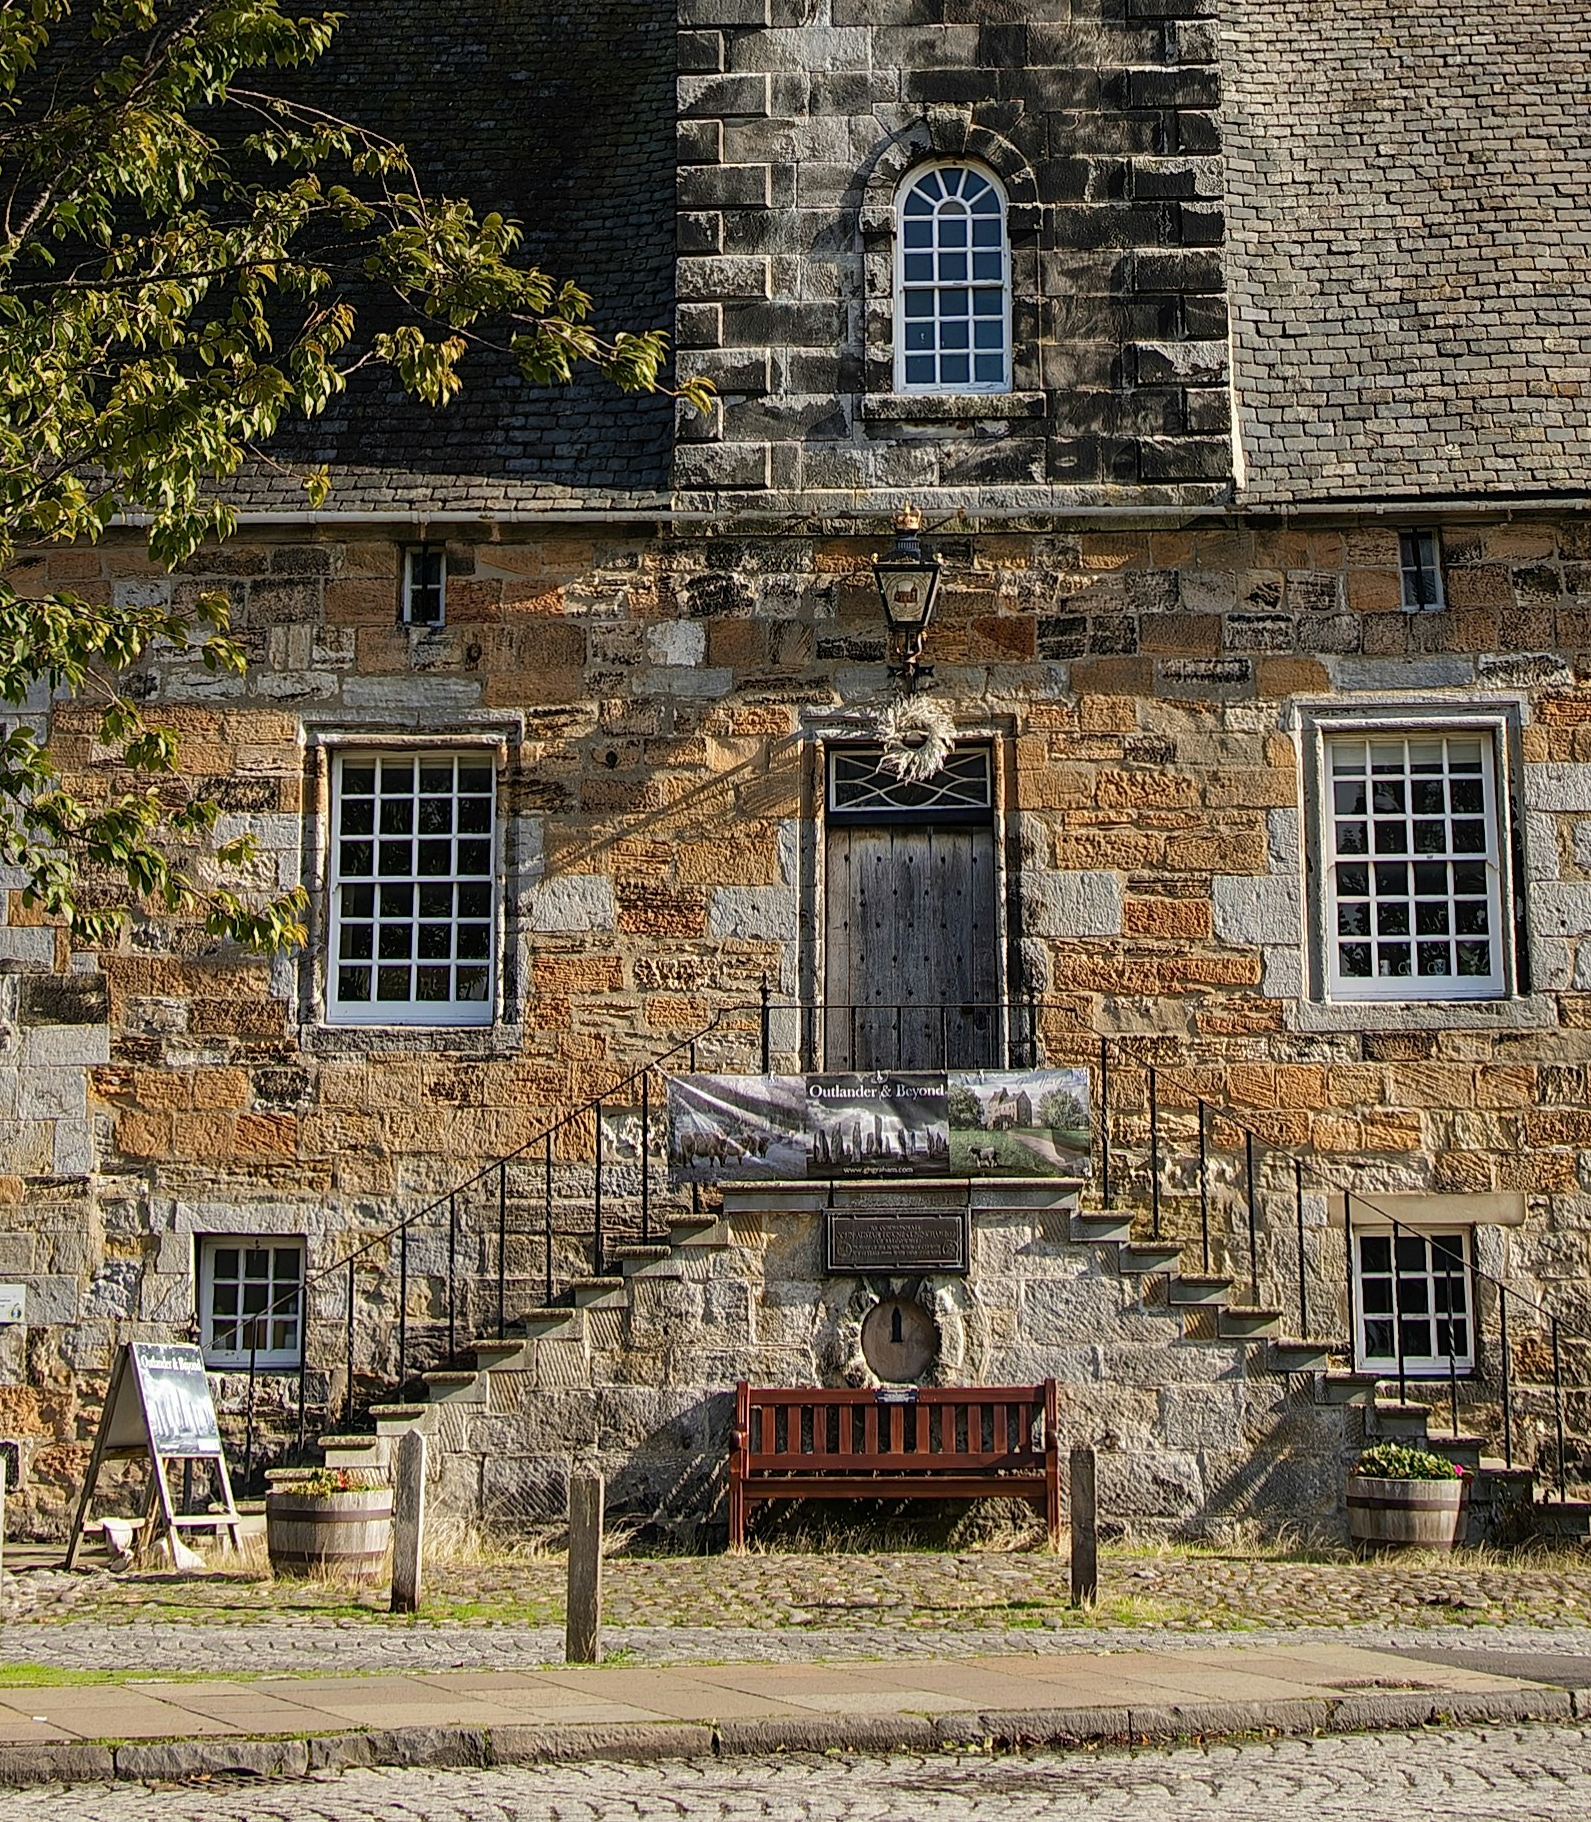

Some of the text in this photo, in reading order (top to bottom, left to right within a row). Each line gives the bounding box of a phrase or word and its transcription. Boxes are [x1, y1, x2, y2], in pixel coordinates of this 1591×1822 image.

[809, 1083, 945, 1100] Outlander & Beyond
[843, 1165, 913, 1175] www.ghgraham.com
